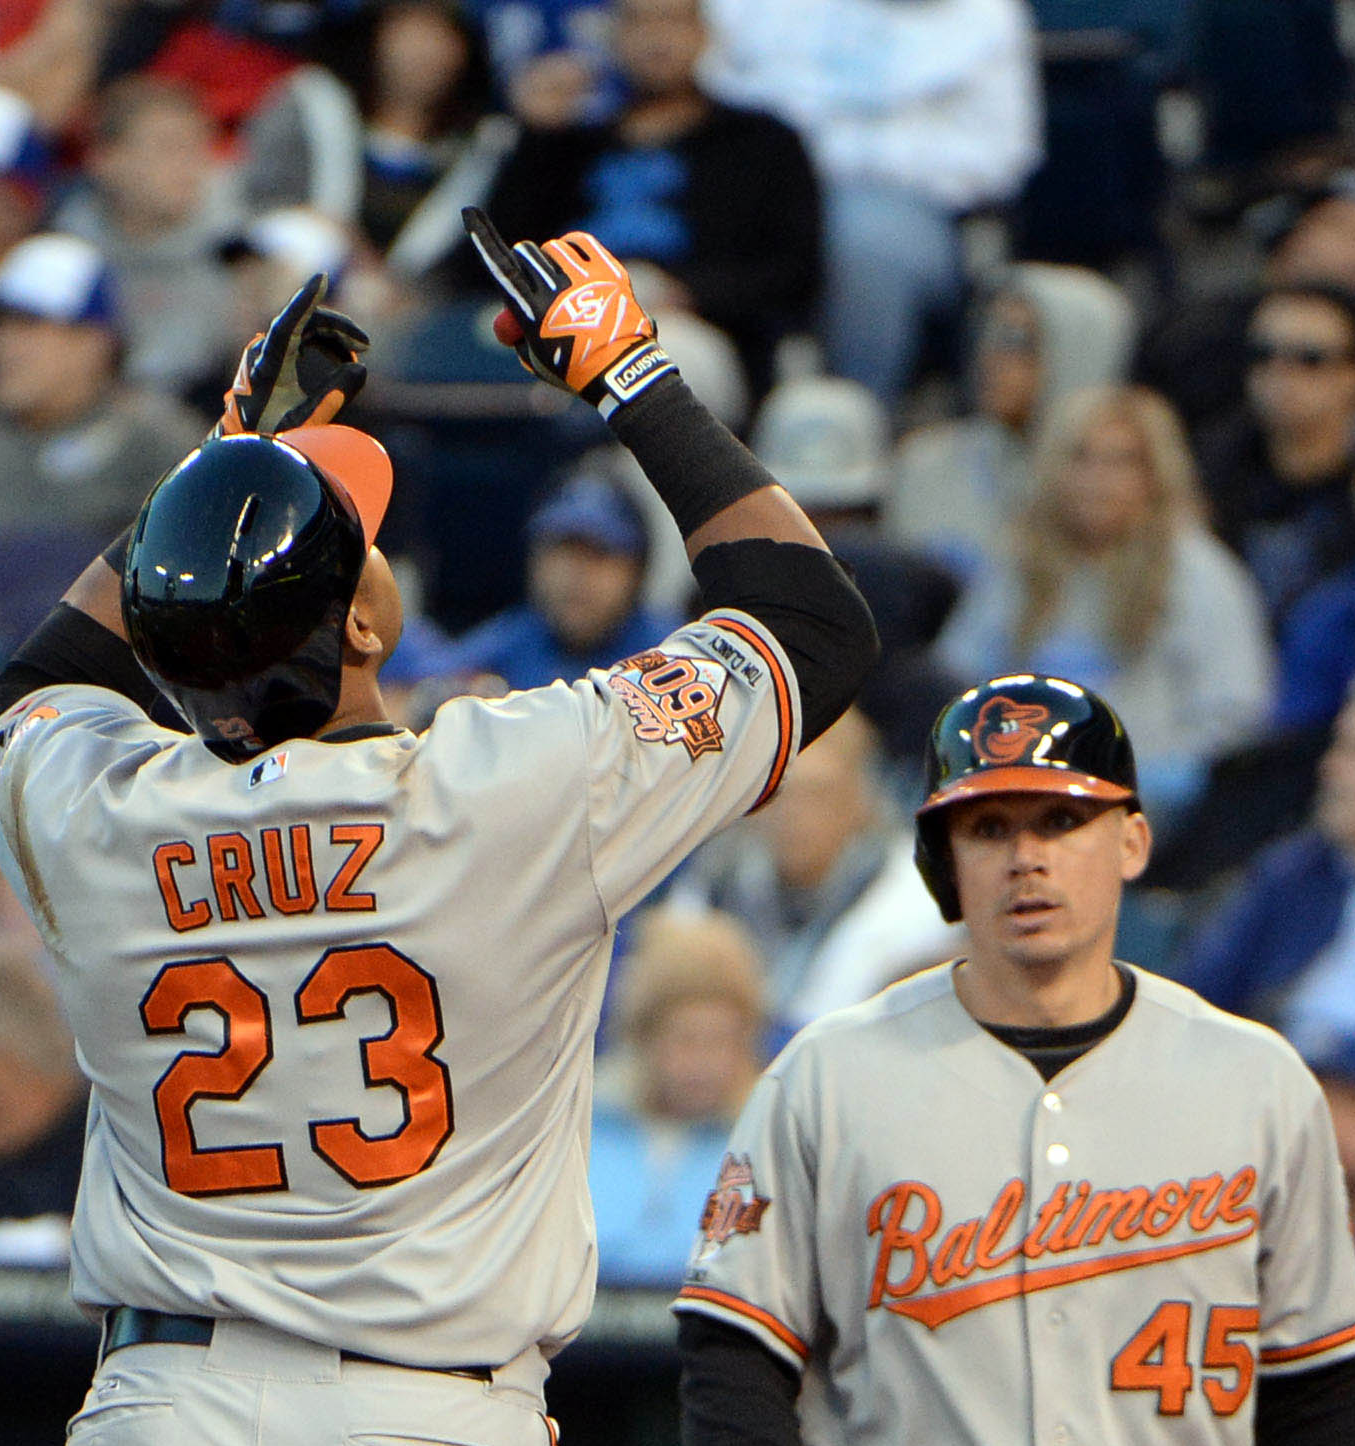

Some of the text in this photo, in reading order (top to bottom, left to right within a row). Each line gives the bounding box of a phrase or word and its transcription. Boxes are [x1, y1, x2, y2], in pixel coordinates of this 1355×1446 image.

[152, 823, 386, 933] CRUZ
[138, 941, 455, 1197] 23
[865, 1165, 1261, 1312] Baltimore
[1110, 1300, 1260, 1417] 45
